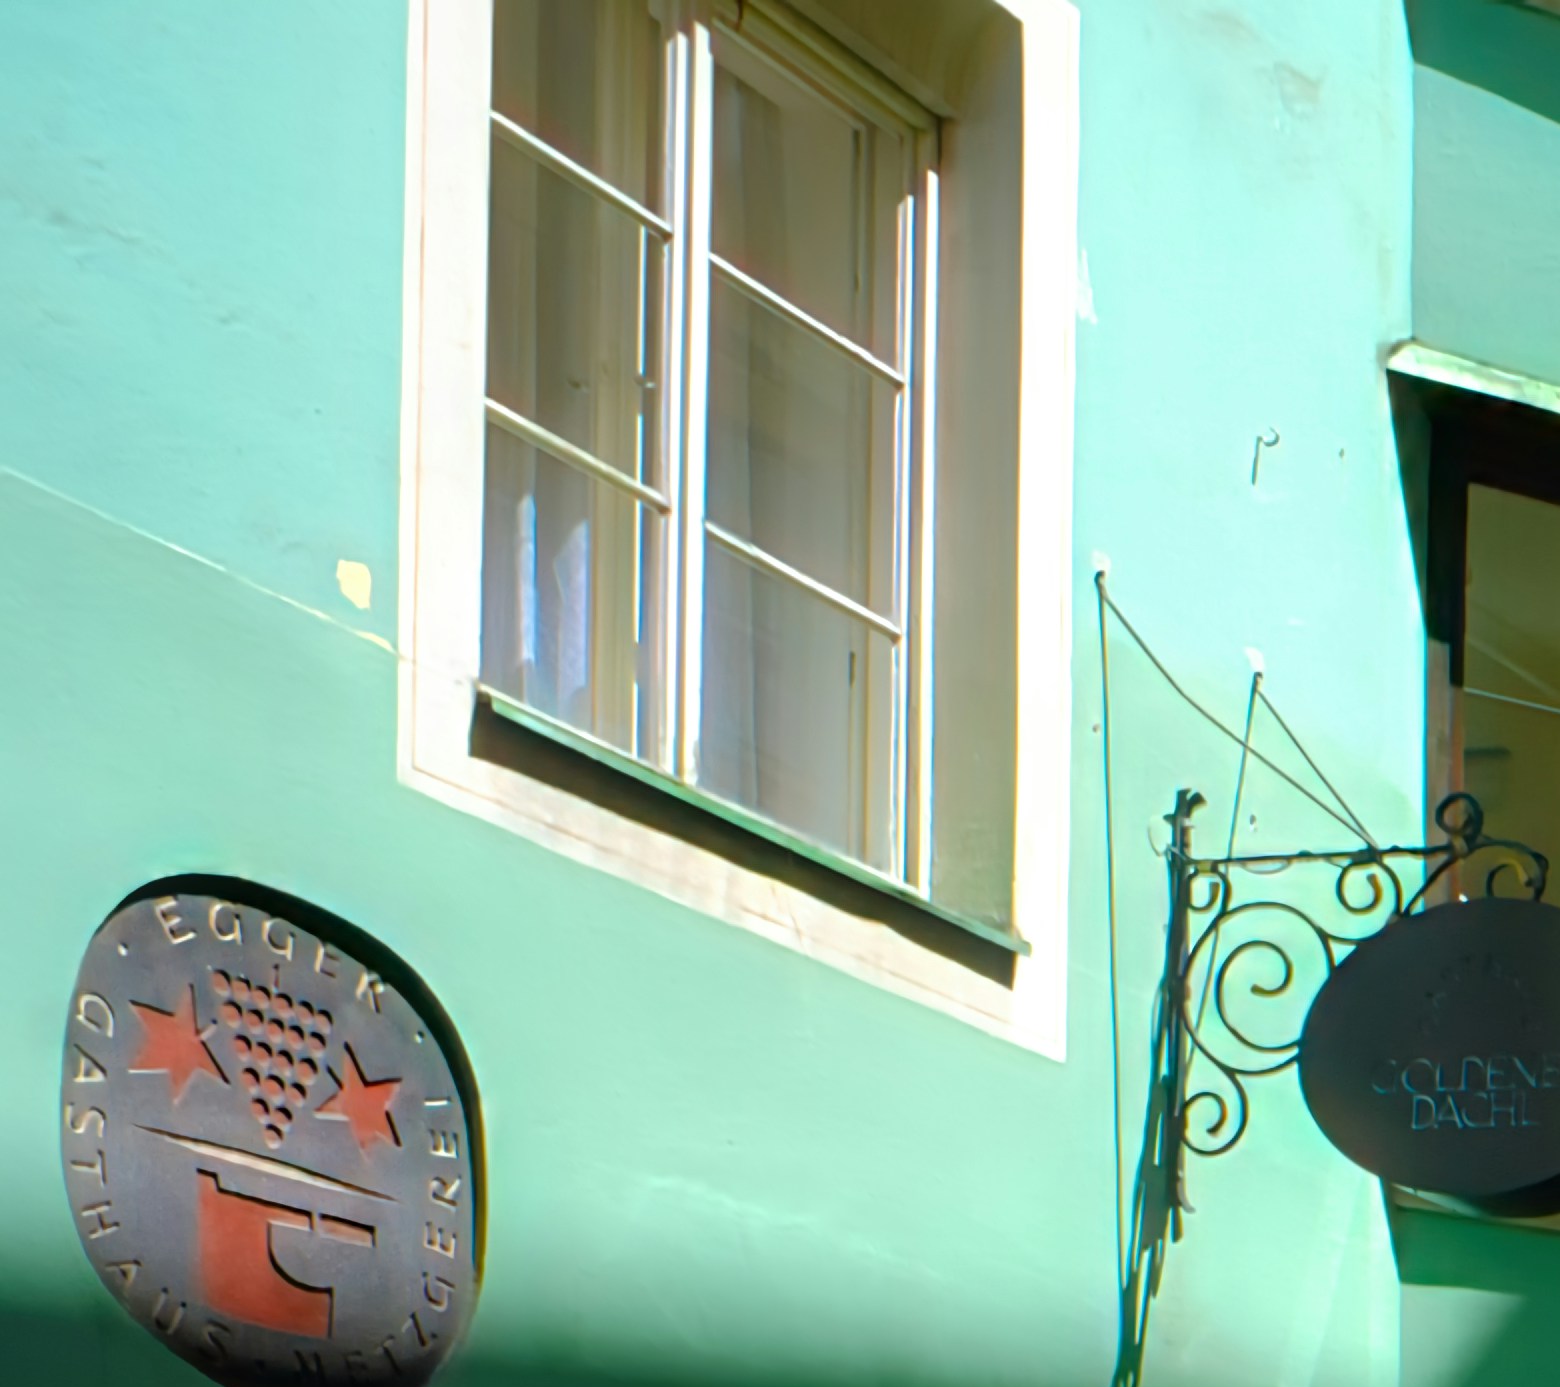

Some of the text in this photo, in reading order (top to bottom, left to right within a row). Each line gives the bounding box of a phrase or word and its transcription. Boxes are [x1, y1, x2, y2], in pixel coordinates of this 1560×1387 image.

[153, 895, 388, 1013] EGGER
[64, 990, 233, 1369] GASTHAUS
[1411, 1092, 1541, 1132] DACHL
[292, 1094, 462, 1382] METZGEREI
